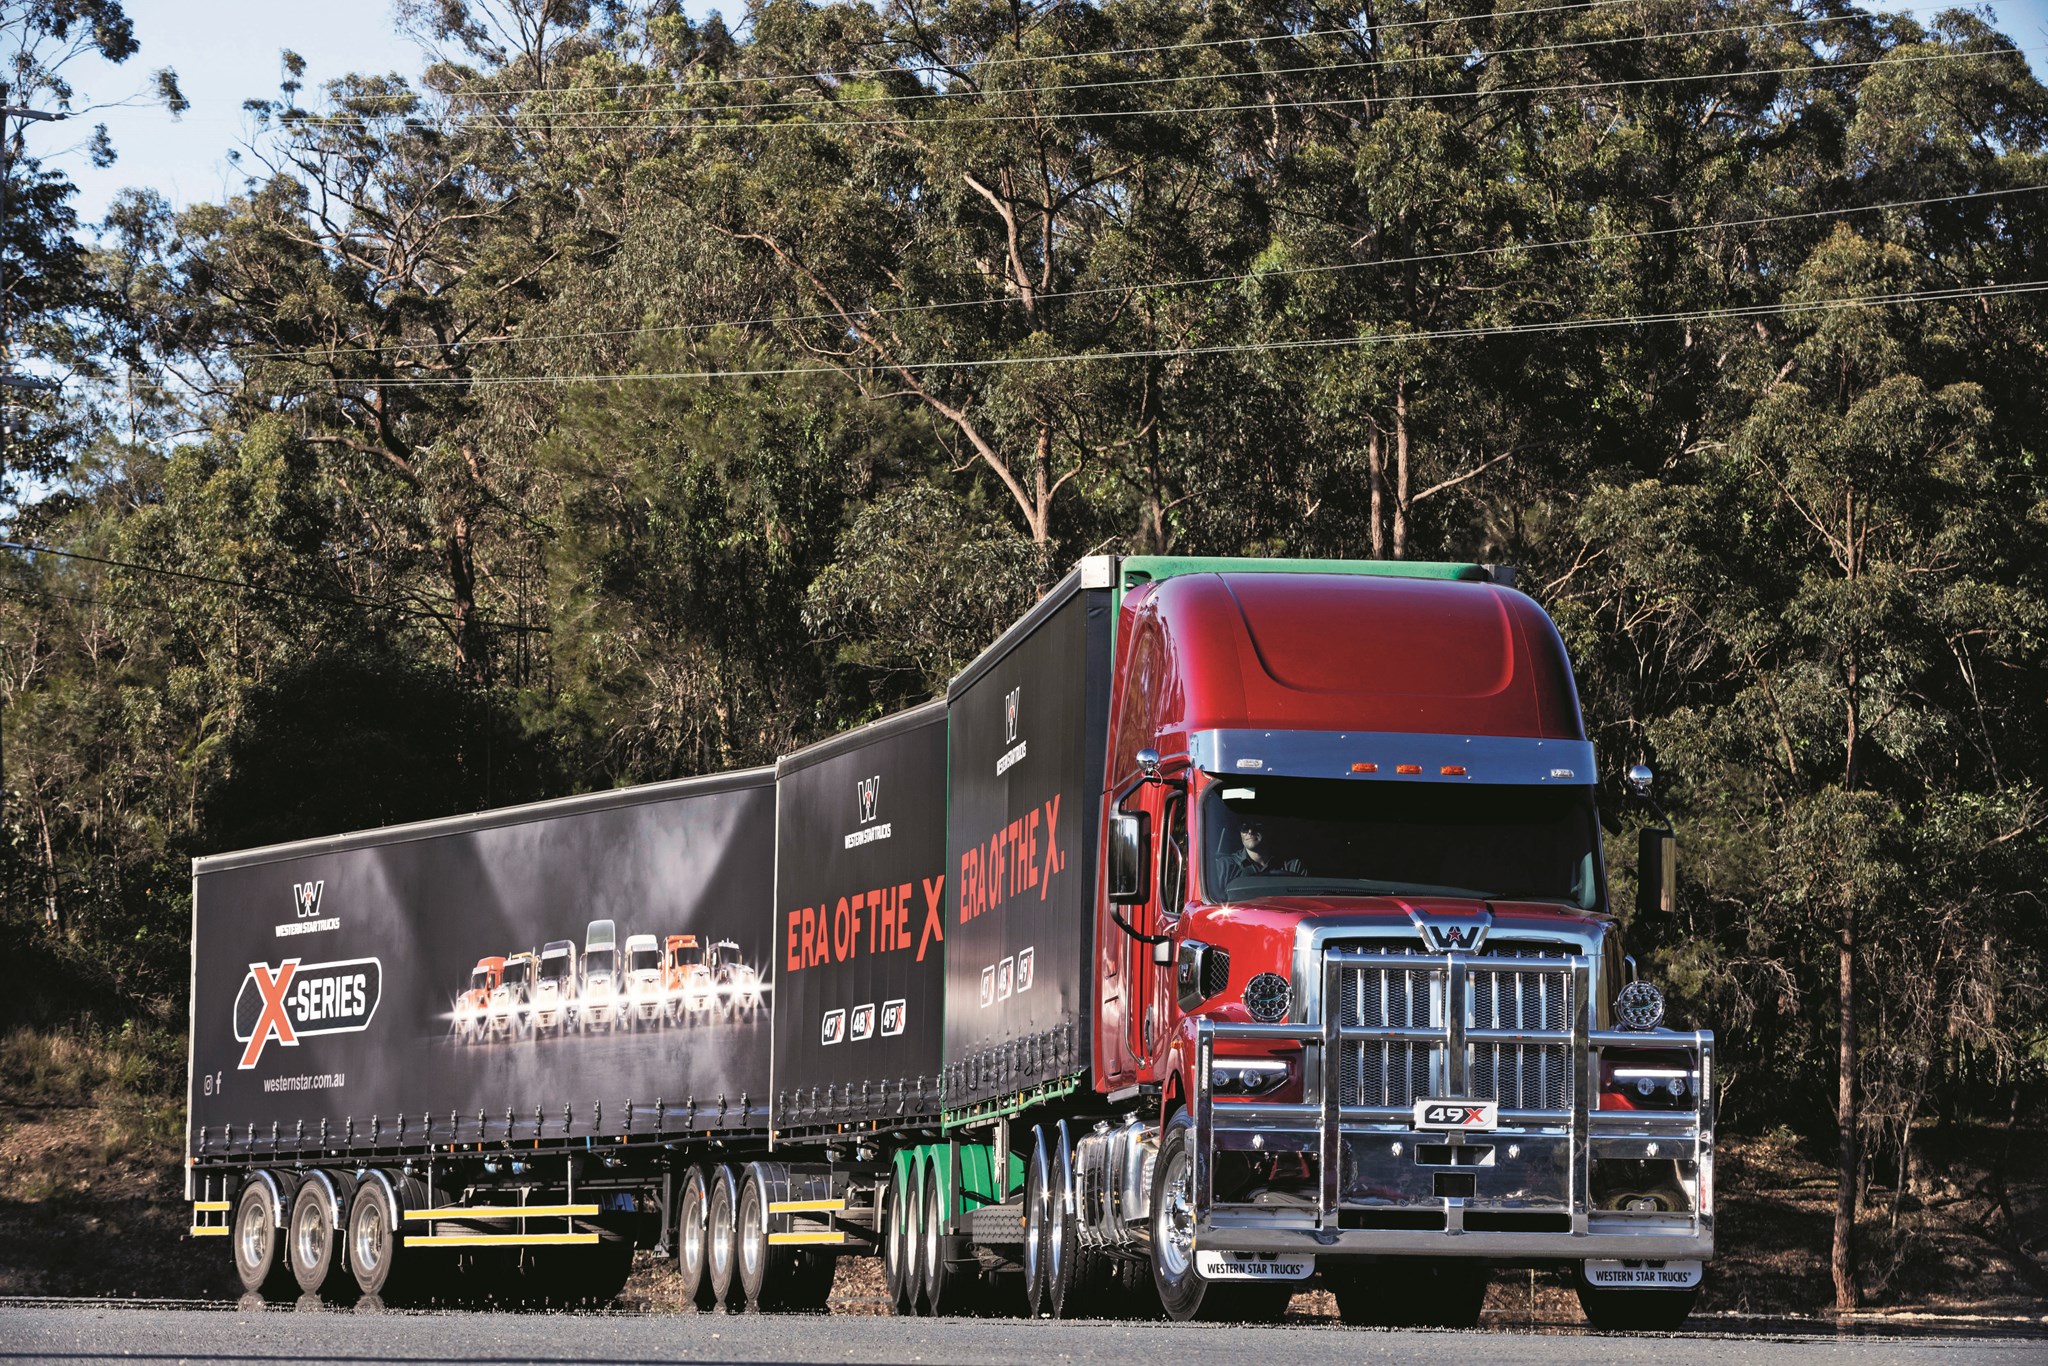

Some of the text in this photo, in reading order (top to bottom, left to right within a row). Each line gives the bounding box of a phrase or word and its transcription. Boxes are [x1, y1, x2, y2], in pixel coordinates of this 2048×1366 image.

[960, 793, 1065, 925] ERA OF THE X.
[787, 875, 945, 972] ERA OF THE X
[237, 957, 366, 1070] X-SERIES
[853, 1009, 873, 1037] 48X
[883, 1005, 904, 1032] 49X
[824, 1015, 843, 1041] 47X
[264, 1072, 345, 1093] westernstar.com.au
[1428, 1107, 1485, 1125] 49X
[1207, 1263, 1245, 1274] WESTERN
[1248, 1263, 1267, 1274] STAR
[1596, 1270, 1633, 1282] WESTERN
[1636, 1271, 1655, 1282] STAR
